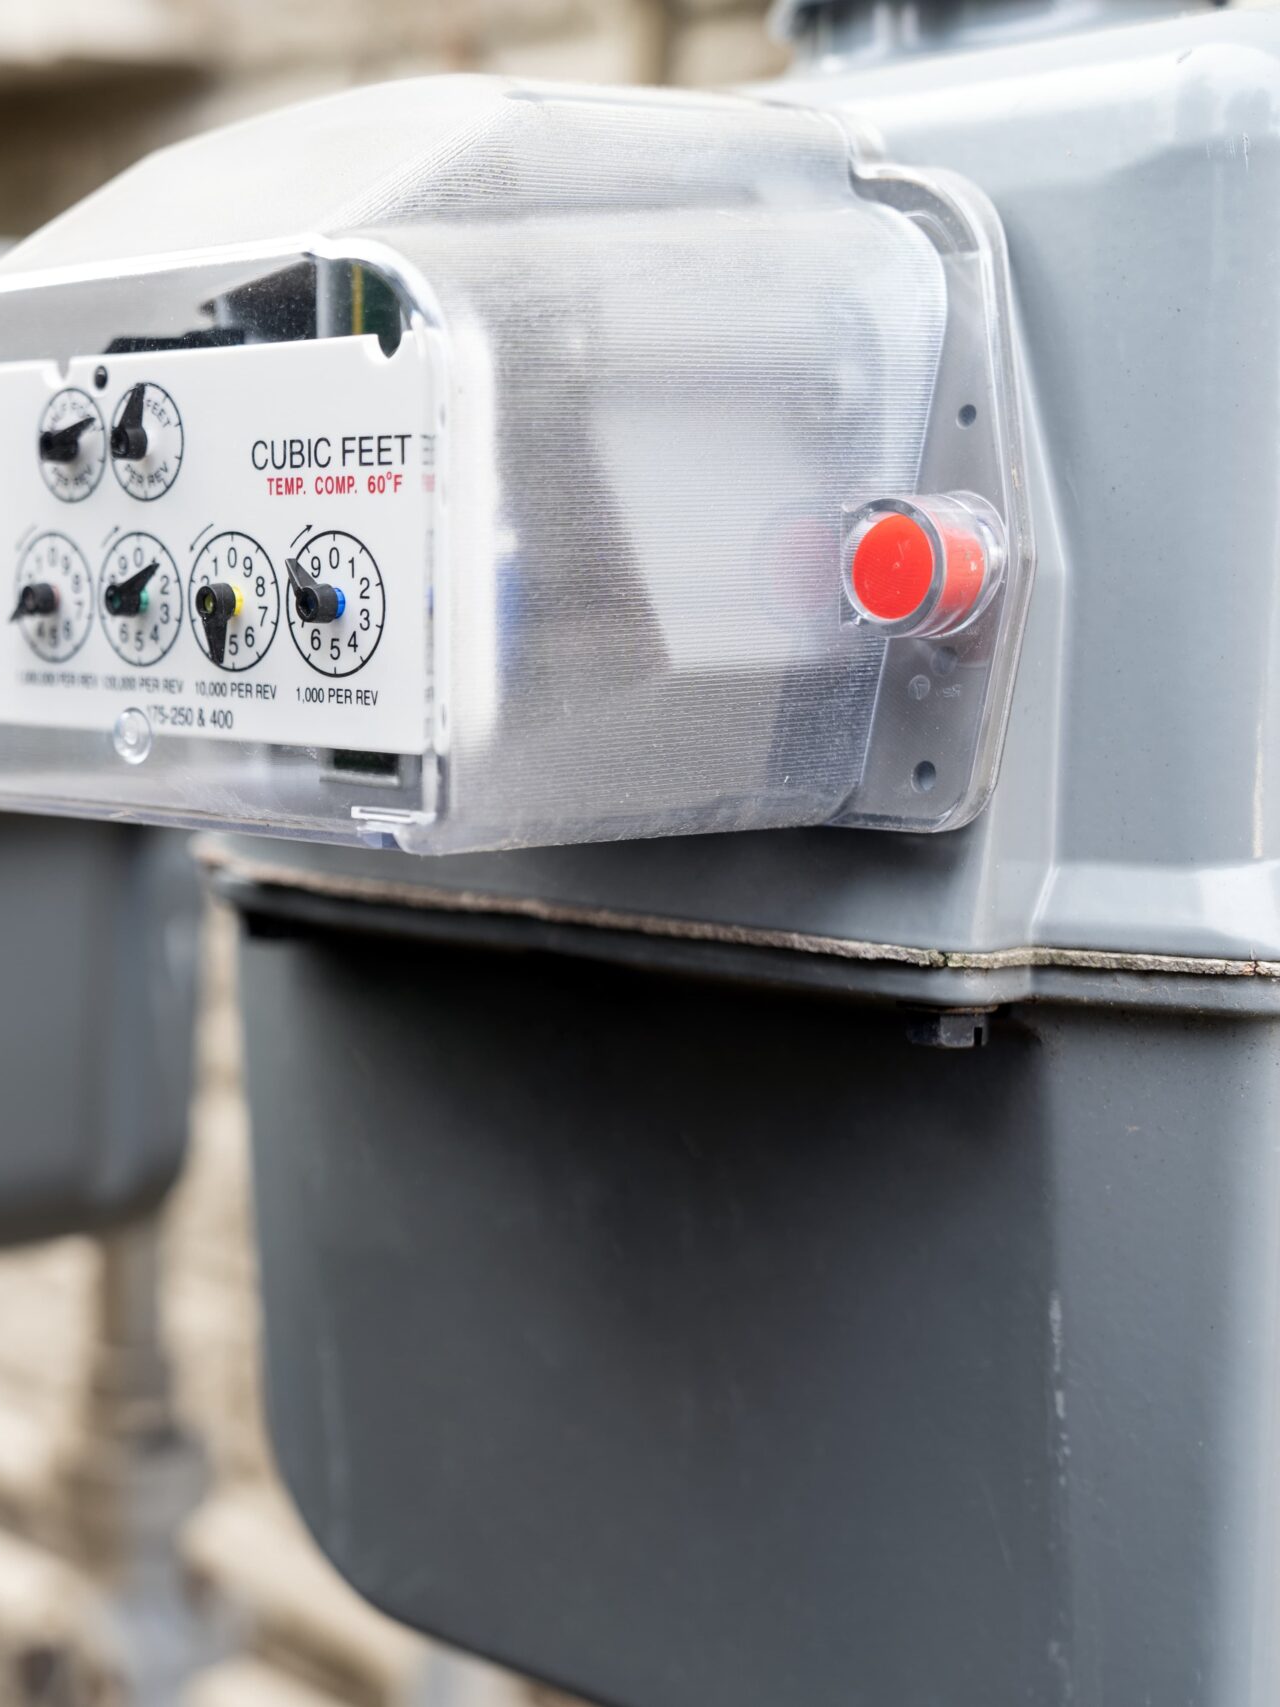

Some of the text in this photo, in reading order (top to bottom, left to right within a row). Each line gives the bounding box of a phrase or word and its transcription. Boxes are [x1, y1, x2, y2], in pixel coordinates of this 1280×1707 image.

[251, 437, 332, 471] CUBIC
[341, 434, 412, 467] FEET
[147, 461, 168, 485] REV
[267, 476, 307, 496] TEMP.
[314, 475, 358, 495] COMP.
[367, 471, 403, 494] 60°F
[133, 547, 144, 568] 0
[212, 556, 218, 577] 1
[227, 547, 238, 568] 0
[242, 556, 253, 578] 9
[310, 556, 322, 578] 9
[328, 547, 340, 569] 0
[348, 557, 355, 579] 1
[159, 574, 170, 595] 2
[255, 576, 266, 597] 8
[359, 577, 371, 600] 2
[160, 603, 170, 625] 3
[258, 606, 269, 628] 7
[359, 608, 371, 631] 3
[134, 630, 144, 652] 5
[149, 623, 160, 644] 4
[244, 626, 255, 648] 6
[310, 629, 322, 651] 6
[347, 631, 359, 653] 4
[228, 634, 239, 656] 5
[329, 638, 341, 660] 5
[139, 675, 160, 693] PER
[162, 679, 183, 694] REV
[195, 681, 277, 700] 10,000 PER REV
[296, 687, 379, 706] 1,000 PER REV
[197, 708, 206, 728] &
[210, 708, 234, 730] 400
